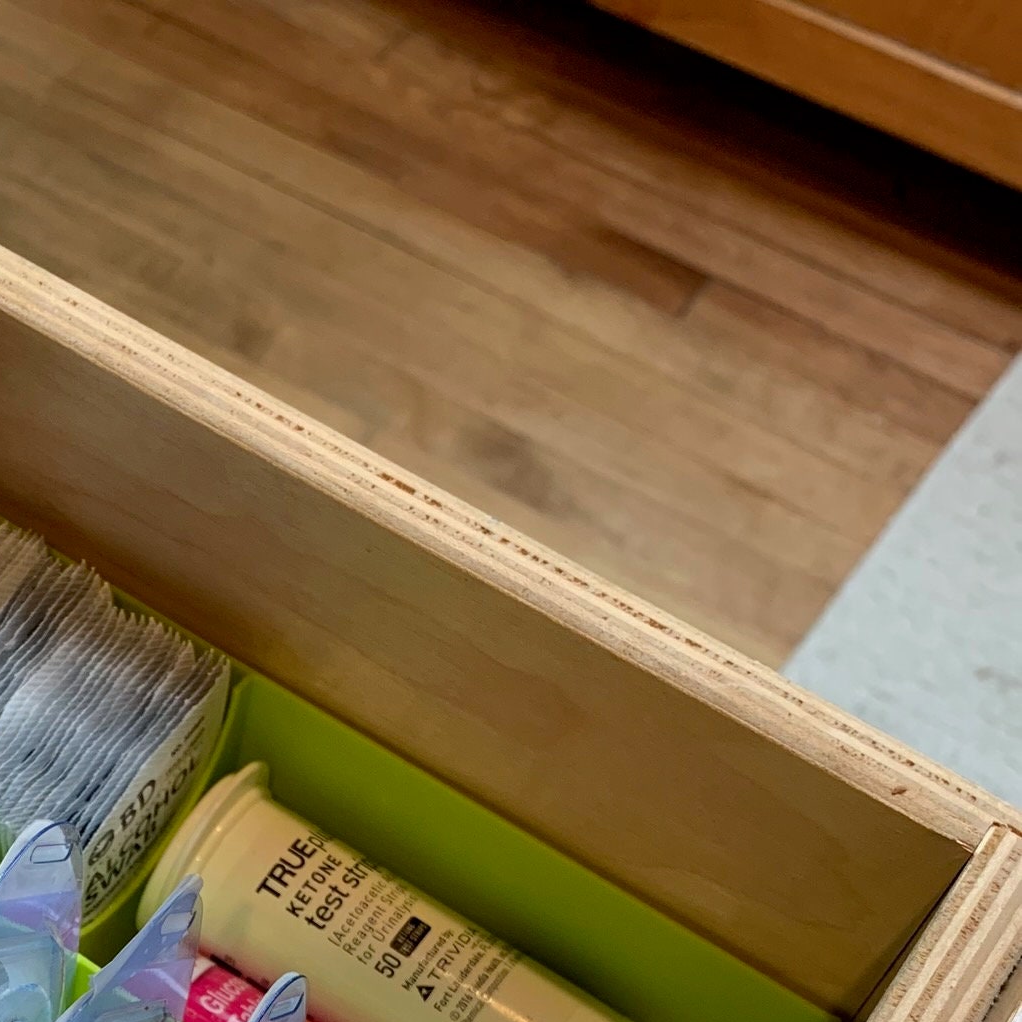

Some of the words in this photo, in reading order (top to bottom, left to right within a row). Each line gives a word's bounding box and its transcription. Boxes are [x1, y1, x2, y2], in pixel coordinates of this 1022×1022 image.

[120, 779, 156, 831] BD
[285, 854, 342, 918] KETONE
[304, 885, 350, 930] test
[342, 905, 386, 955] Reagent
[357, 944, 377, 965] for
[374, 952, 401, 979] 50
[433, 990, 453, 1012] Fort
